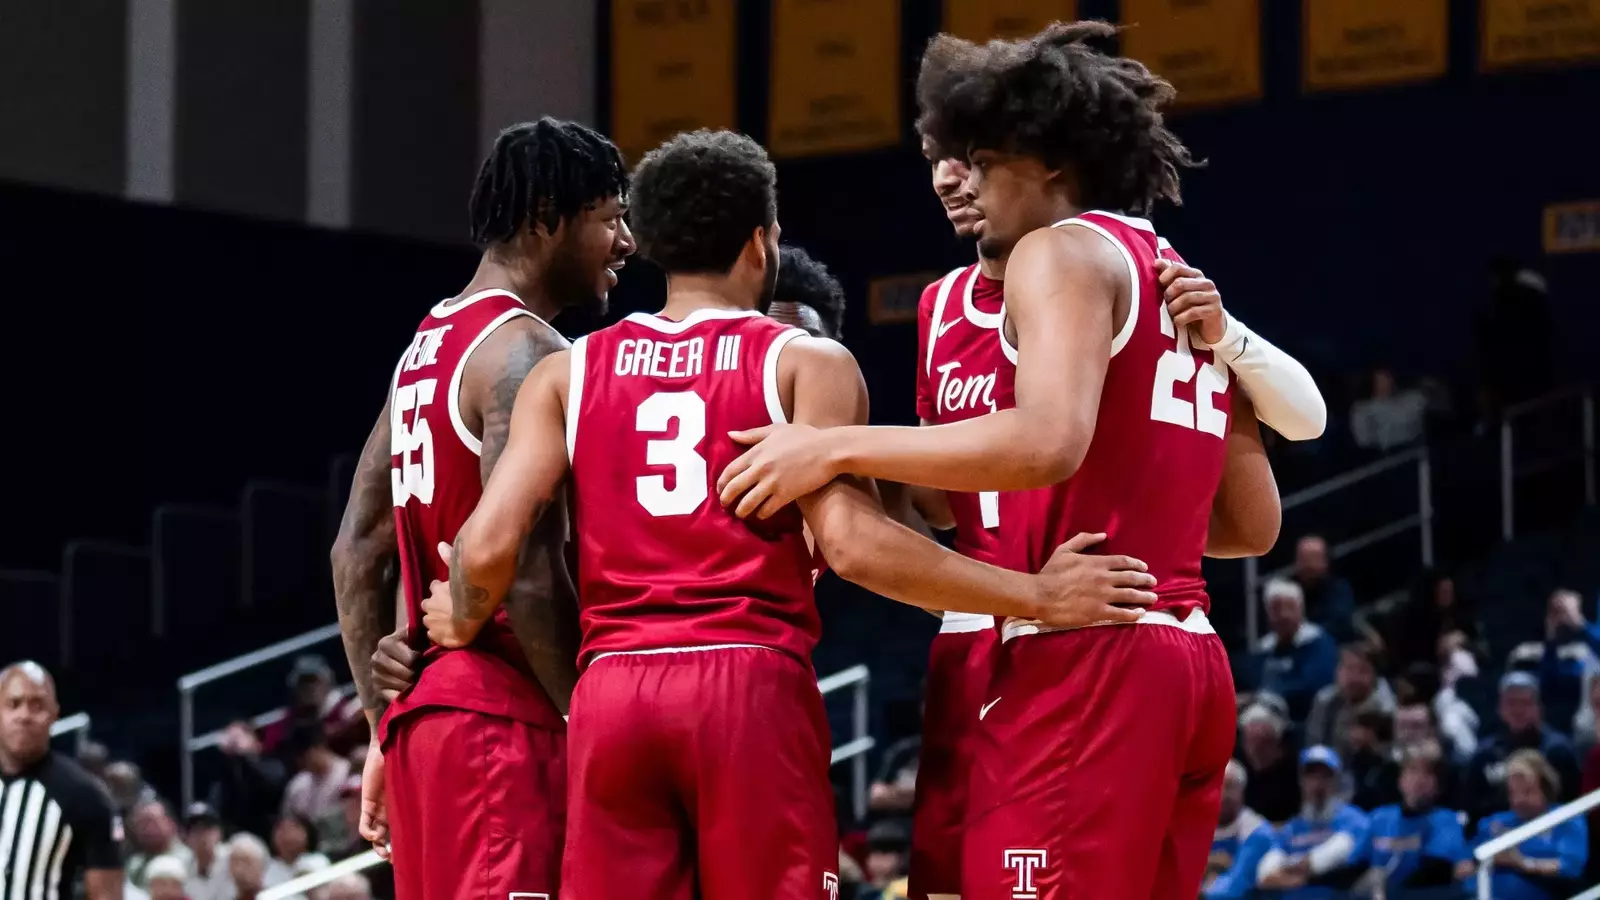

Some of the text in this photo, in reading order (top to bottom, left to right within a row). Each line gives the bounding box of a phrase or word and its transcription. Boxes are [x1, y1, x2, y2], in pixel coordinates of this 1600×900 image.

[614, 335, 741, 378] GREER III
[1150, 298, 1230, 440] 22
[391, 378, 438, 508] 55
[635, 390, 708, 517] 3
[1002, 848, 1047, 899] T
